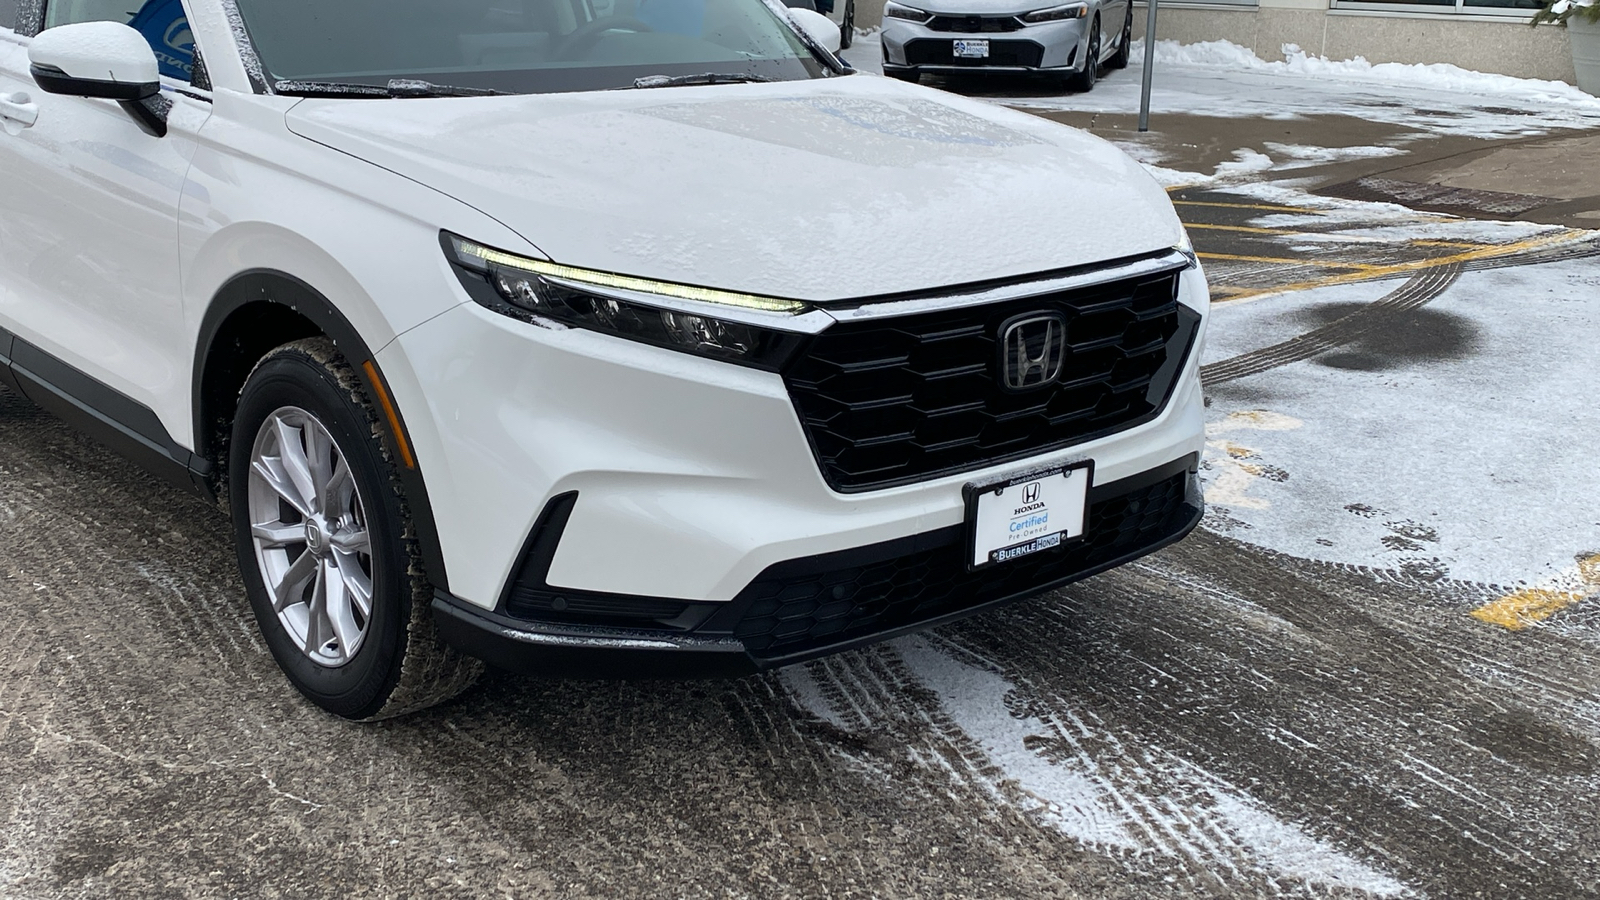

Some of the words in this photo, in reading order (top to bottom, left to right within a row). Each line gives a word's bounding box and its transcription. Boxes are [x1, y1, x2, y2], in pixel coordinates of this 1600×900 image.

[1014, 502, 1045, 515] HONDA
[1010, 513, 1048, 532] Certified
[1009, 525, 1048, 541] Pre-Owned
[999, 543, 1036, 561] BUERKLE
[1037, 536, 1058, 549] HONDA
